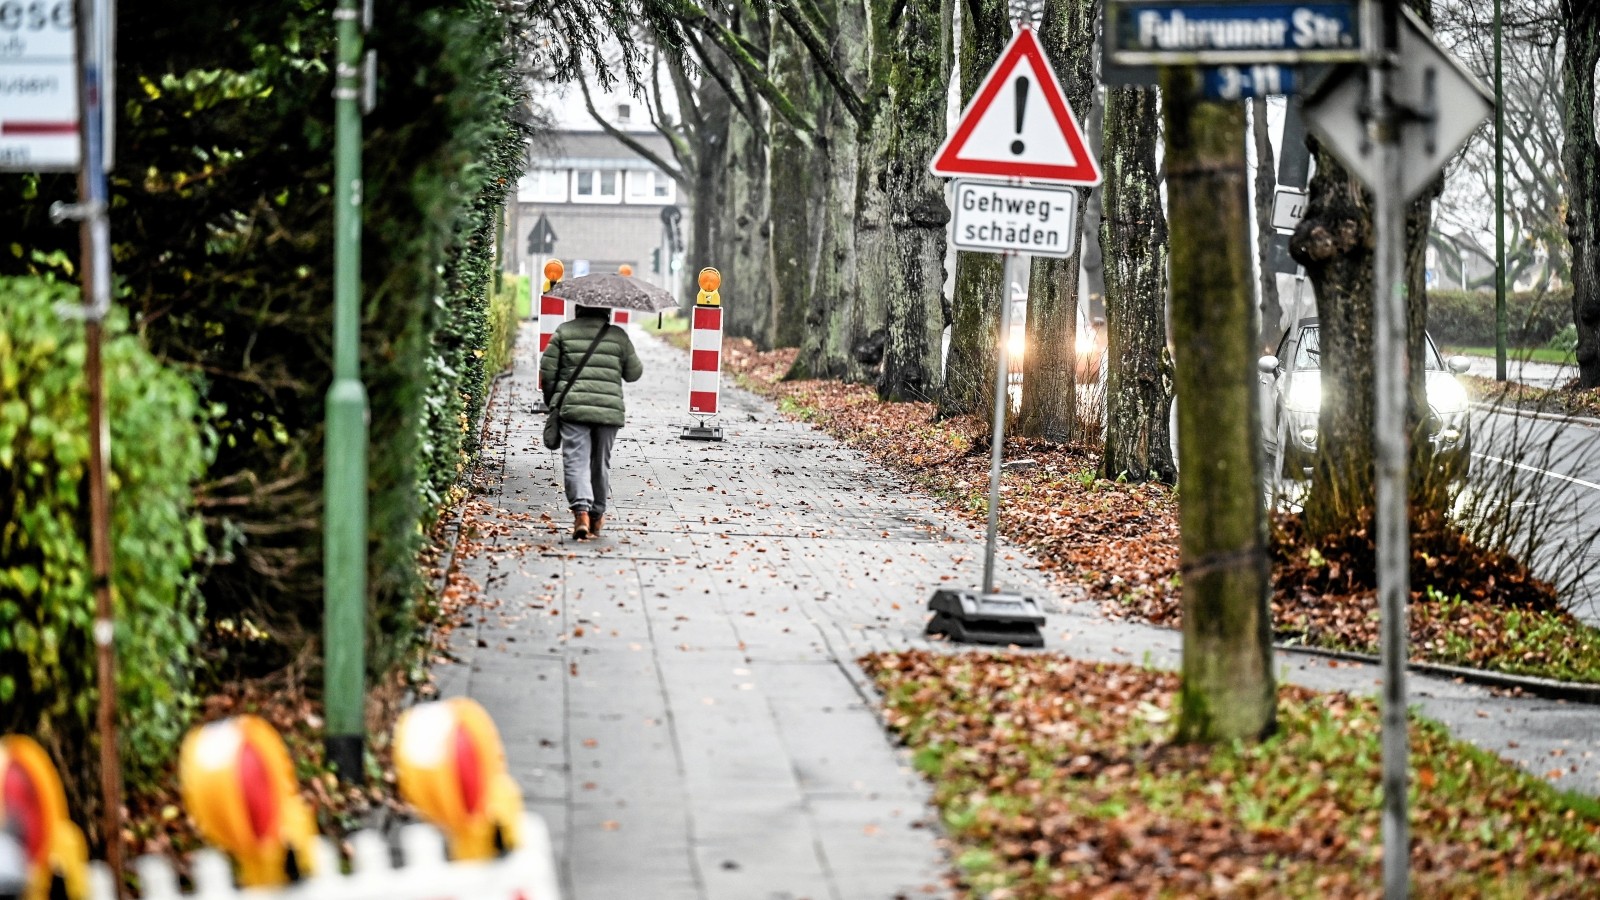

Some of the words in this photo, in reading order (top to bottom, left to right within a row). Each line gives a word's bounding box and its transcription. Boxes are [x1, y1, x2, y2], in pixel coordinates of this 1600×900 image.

[1292, 8, 1352, 47] Str.
[962, 189, 1064, 222] Gehweg-
[965, 220, 1059, 246] schäden
